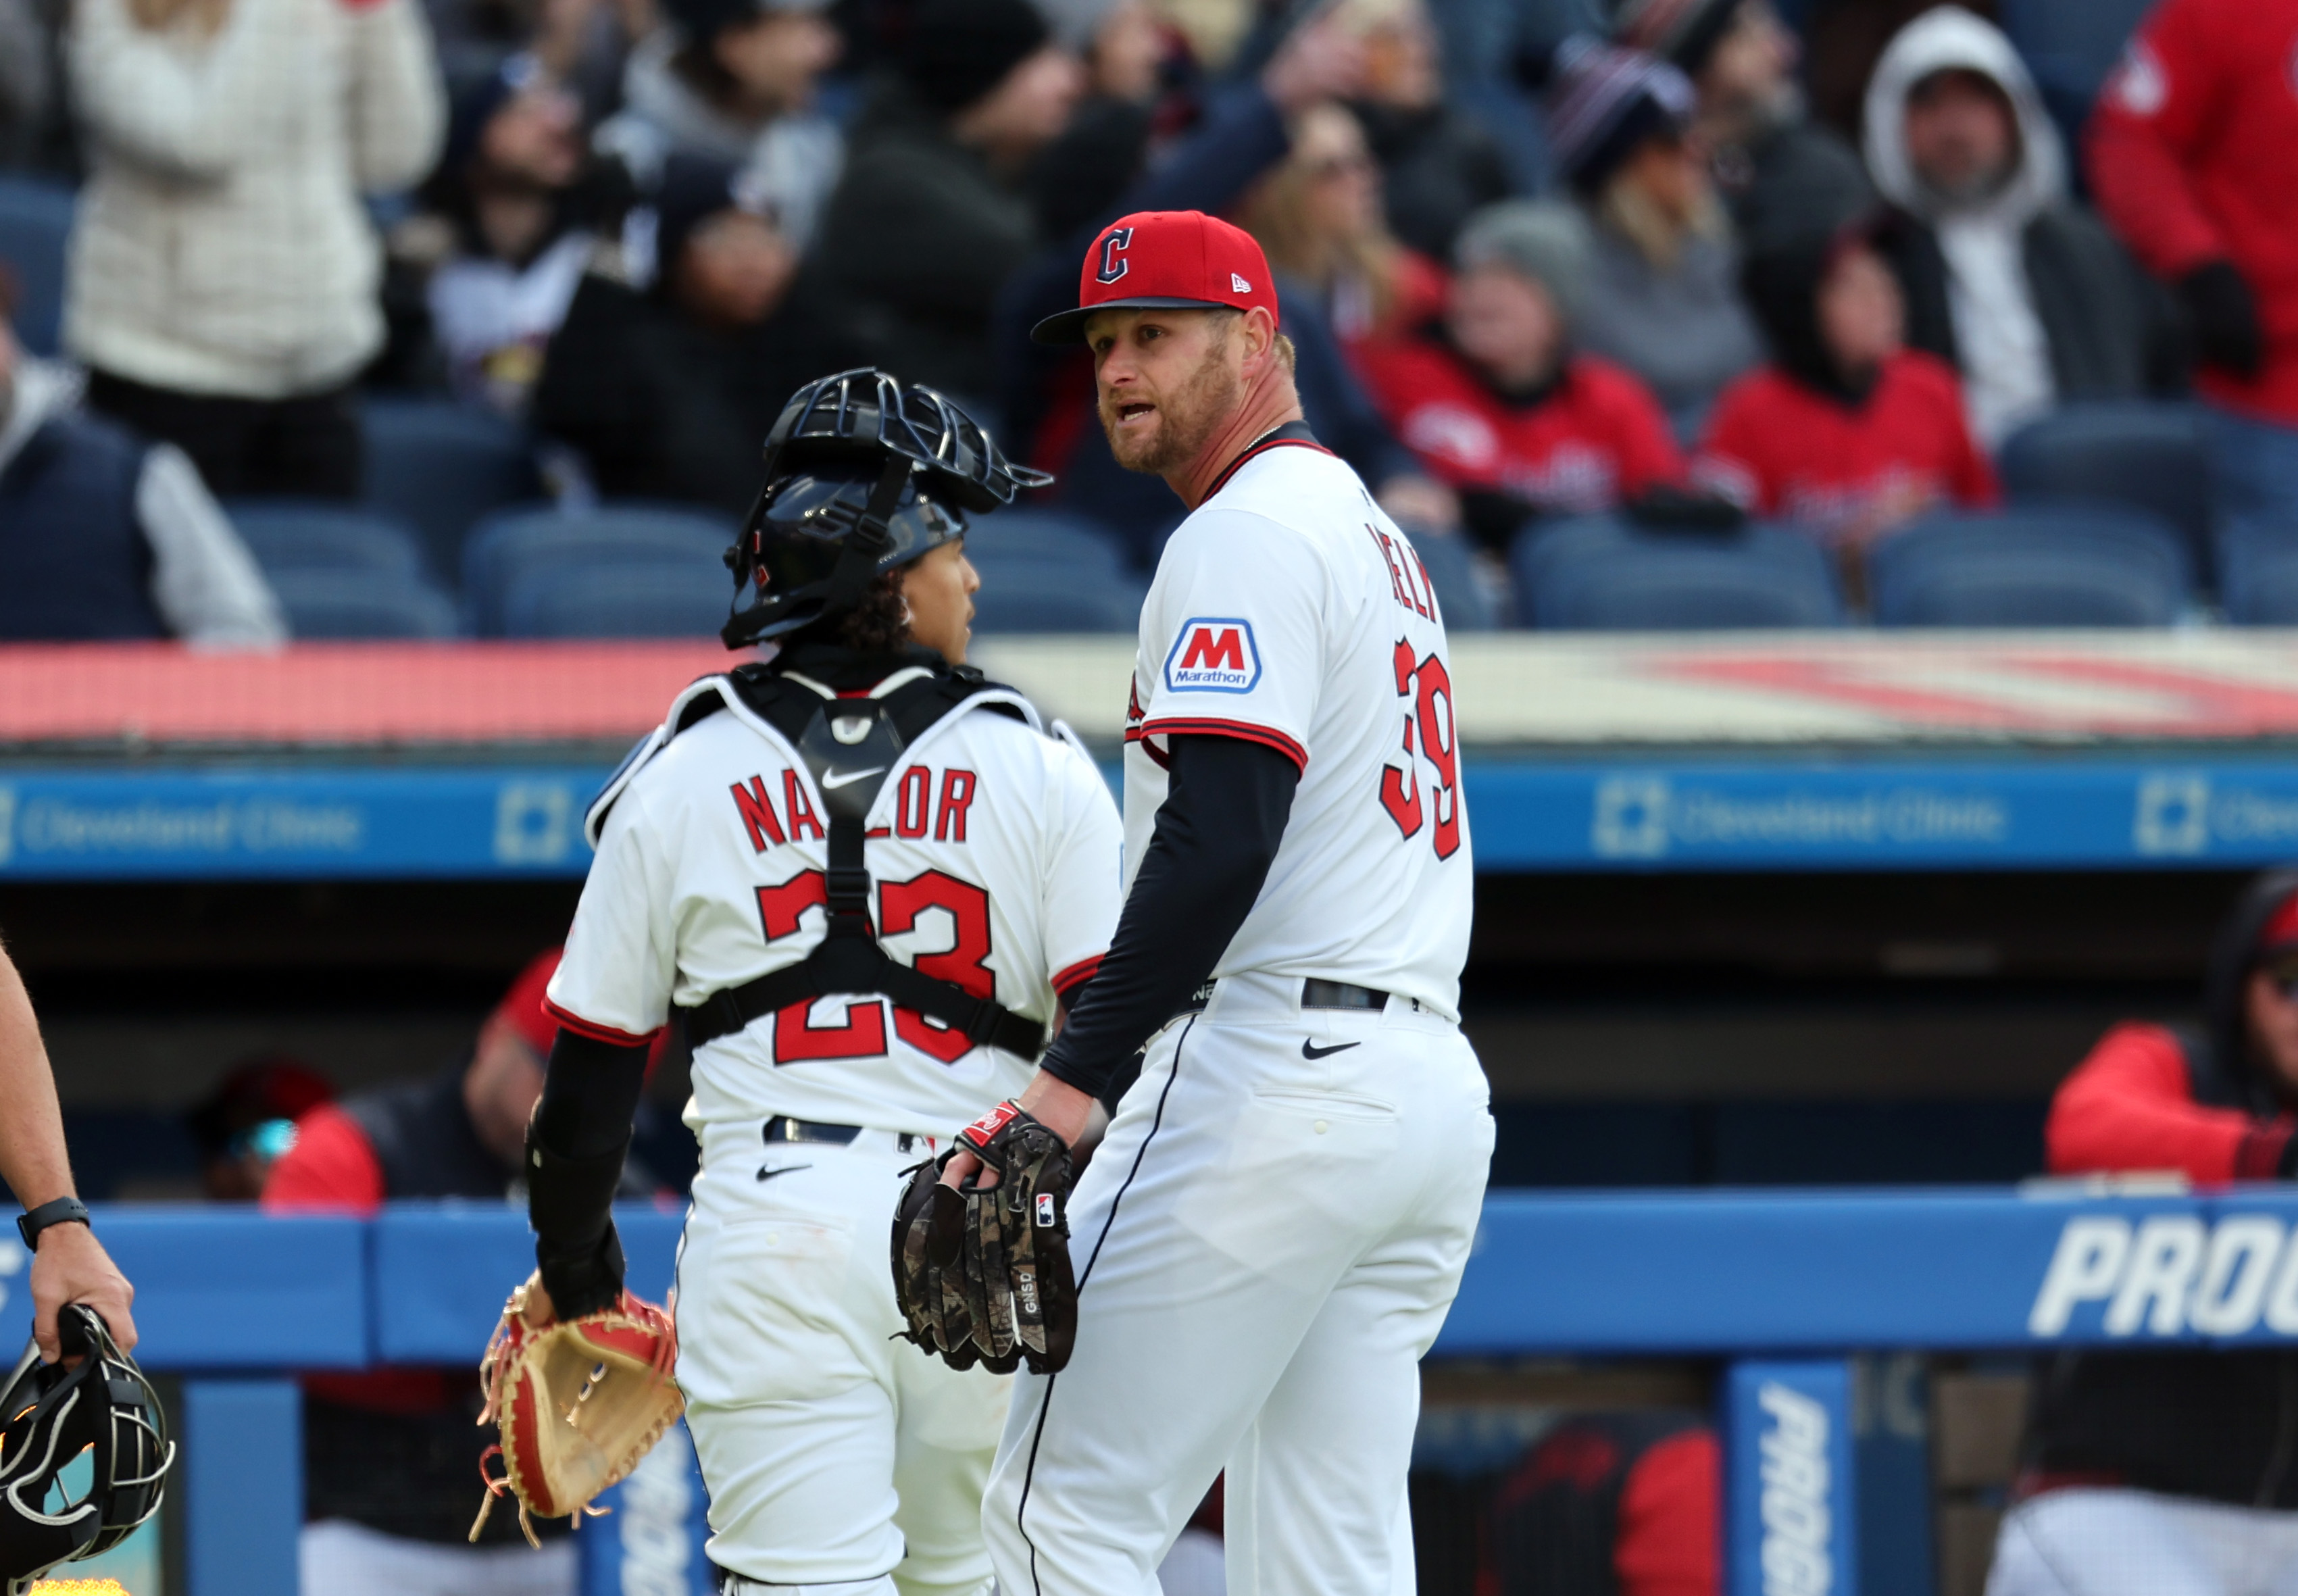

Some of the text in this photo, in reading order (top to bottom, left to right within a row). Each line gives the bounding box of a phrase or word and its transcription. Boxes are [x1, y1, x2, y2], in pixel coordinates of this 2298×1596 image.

[1095, 227, 1134, 284] C
[1174, 670, 1247, 684] Marathon
[1179, 628, 1245, 670] M
[1378, 634, 1460, 862] 39
[730, 765, 977, 854] NAOR
[753, 868, 996, 1066] 23
[1759, 1382, 1832, 1596] PROG
